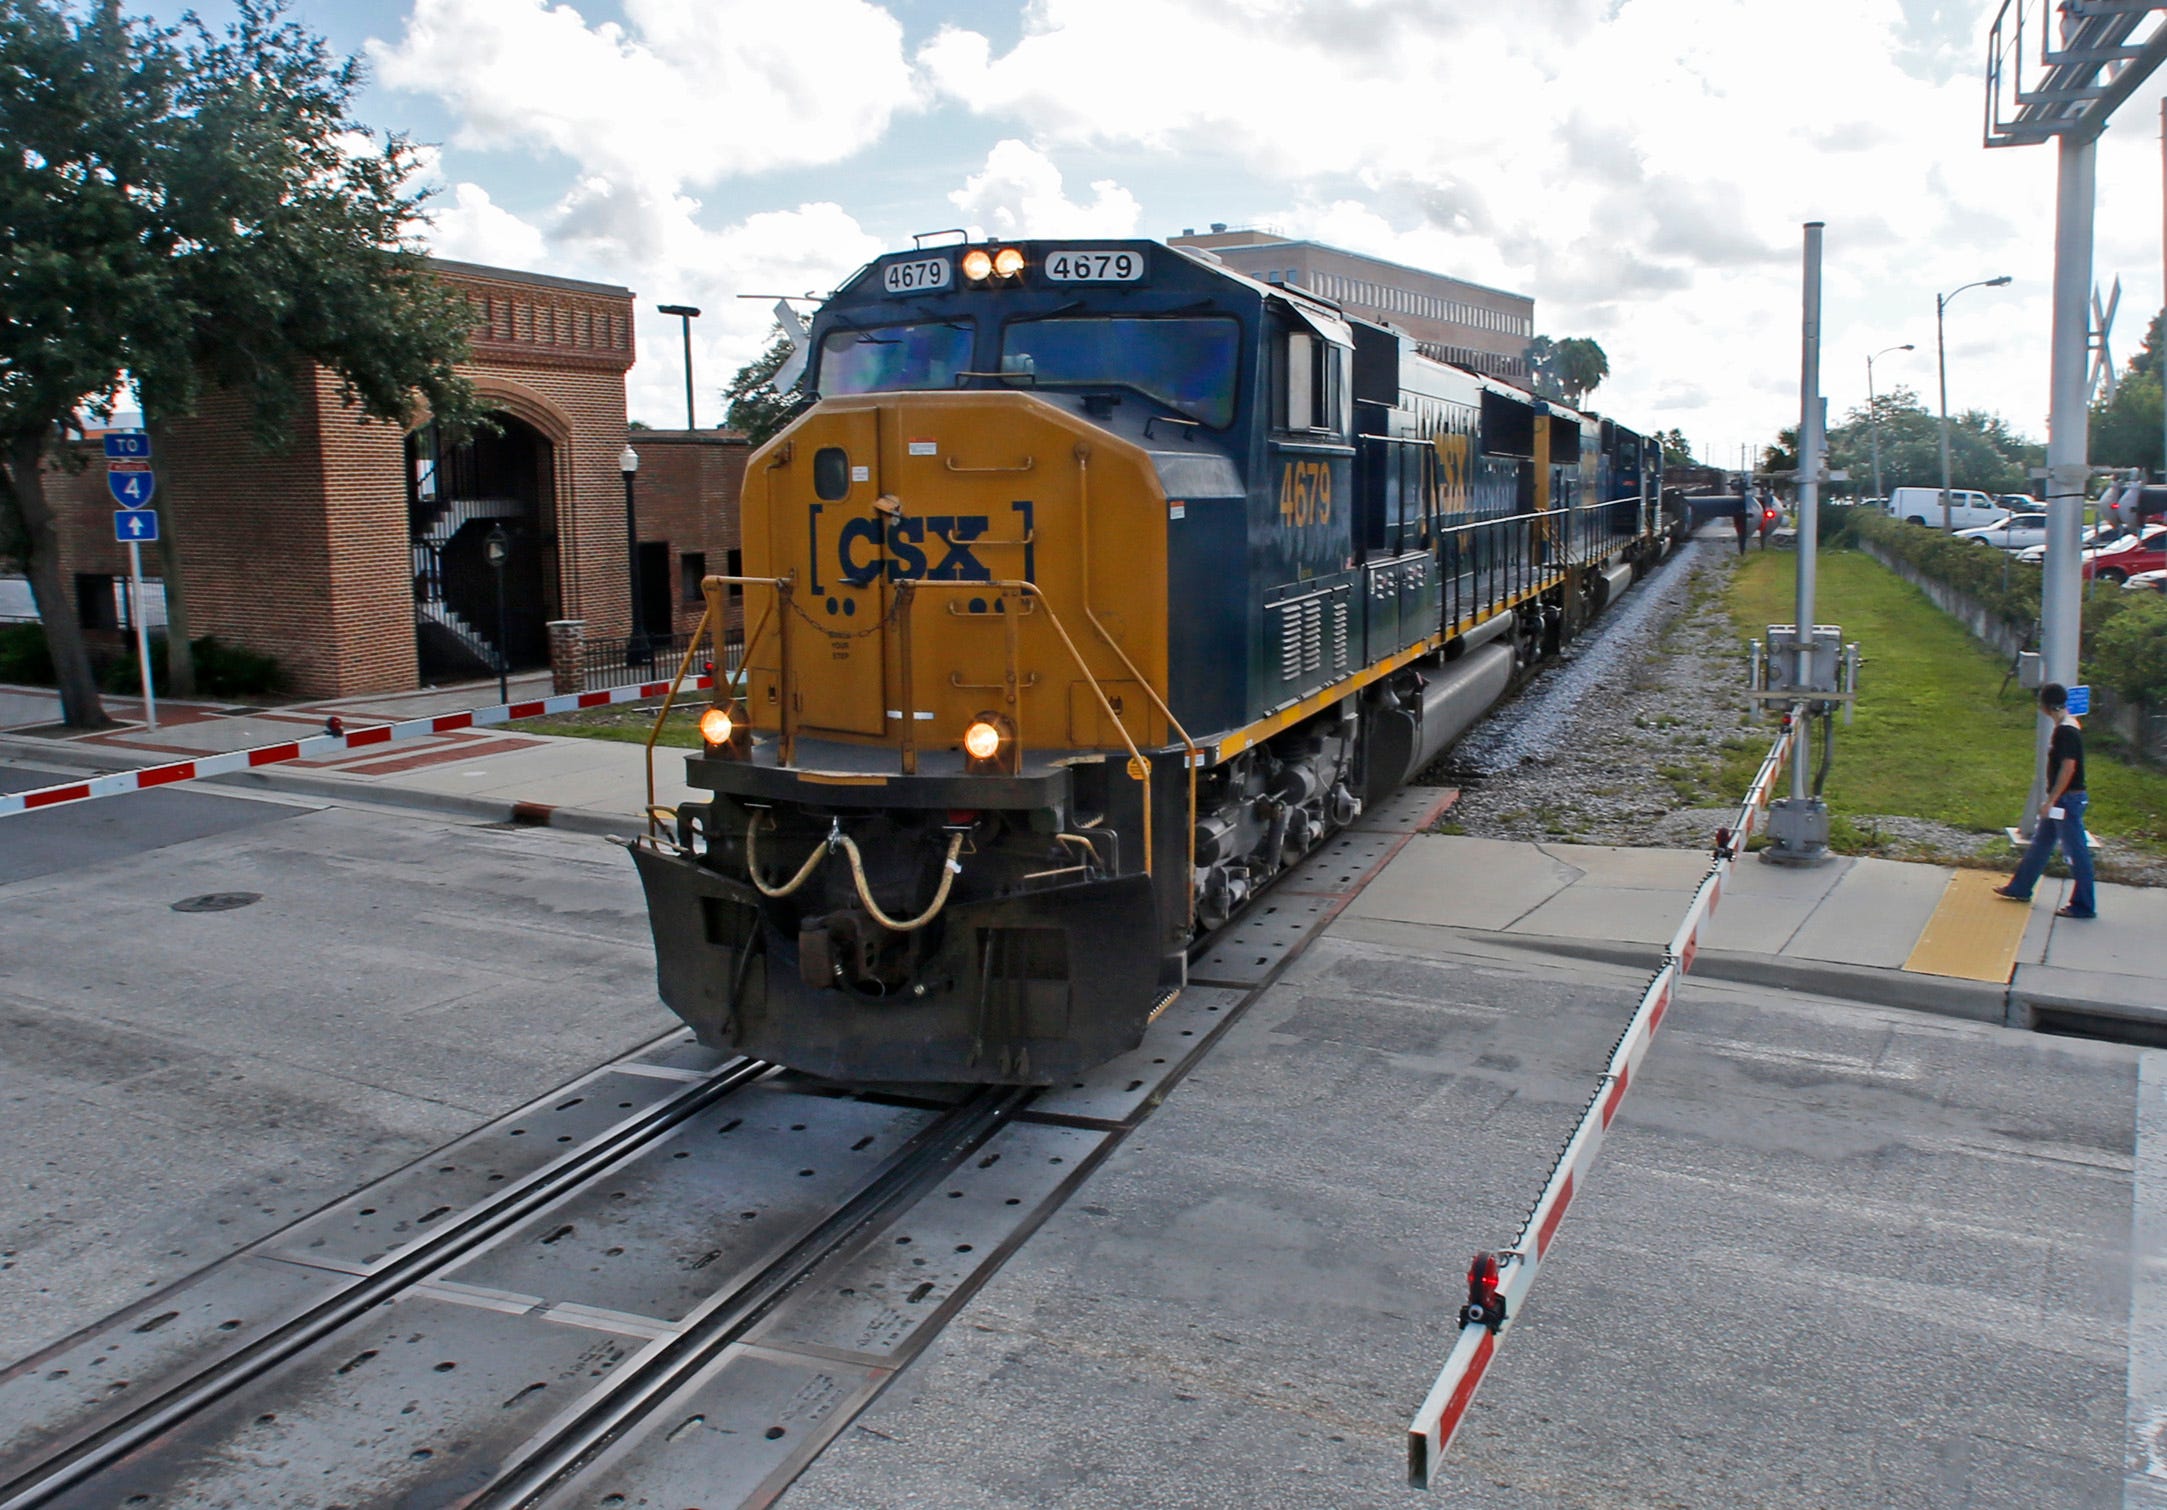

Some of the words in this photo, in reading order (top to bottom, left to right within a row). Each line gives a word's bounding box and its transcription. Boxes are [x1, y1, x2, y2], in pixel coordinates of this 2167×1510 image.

[889, 261, 941, 288] 4679
[1053, 255, 1132, 279] 4679
[115, 438, 138, 452] TO
[124, 477, 140, 498] 4
[1281, 461, 1331, 527] 4679
[838, 515, 991, 586] CSX
